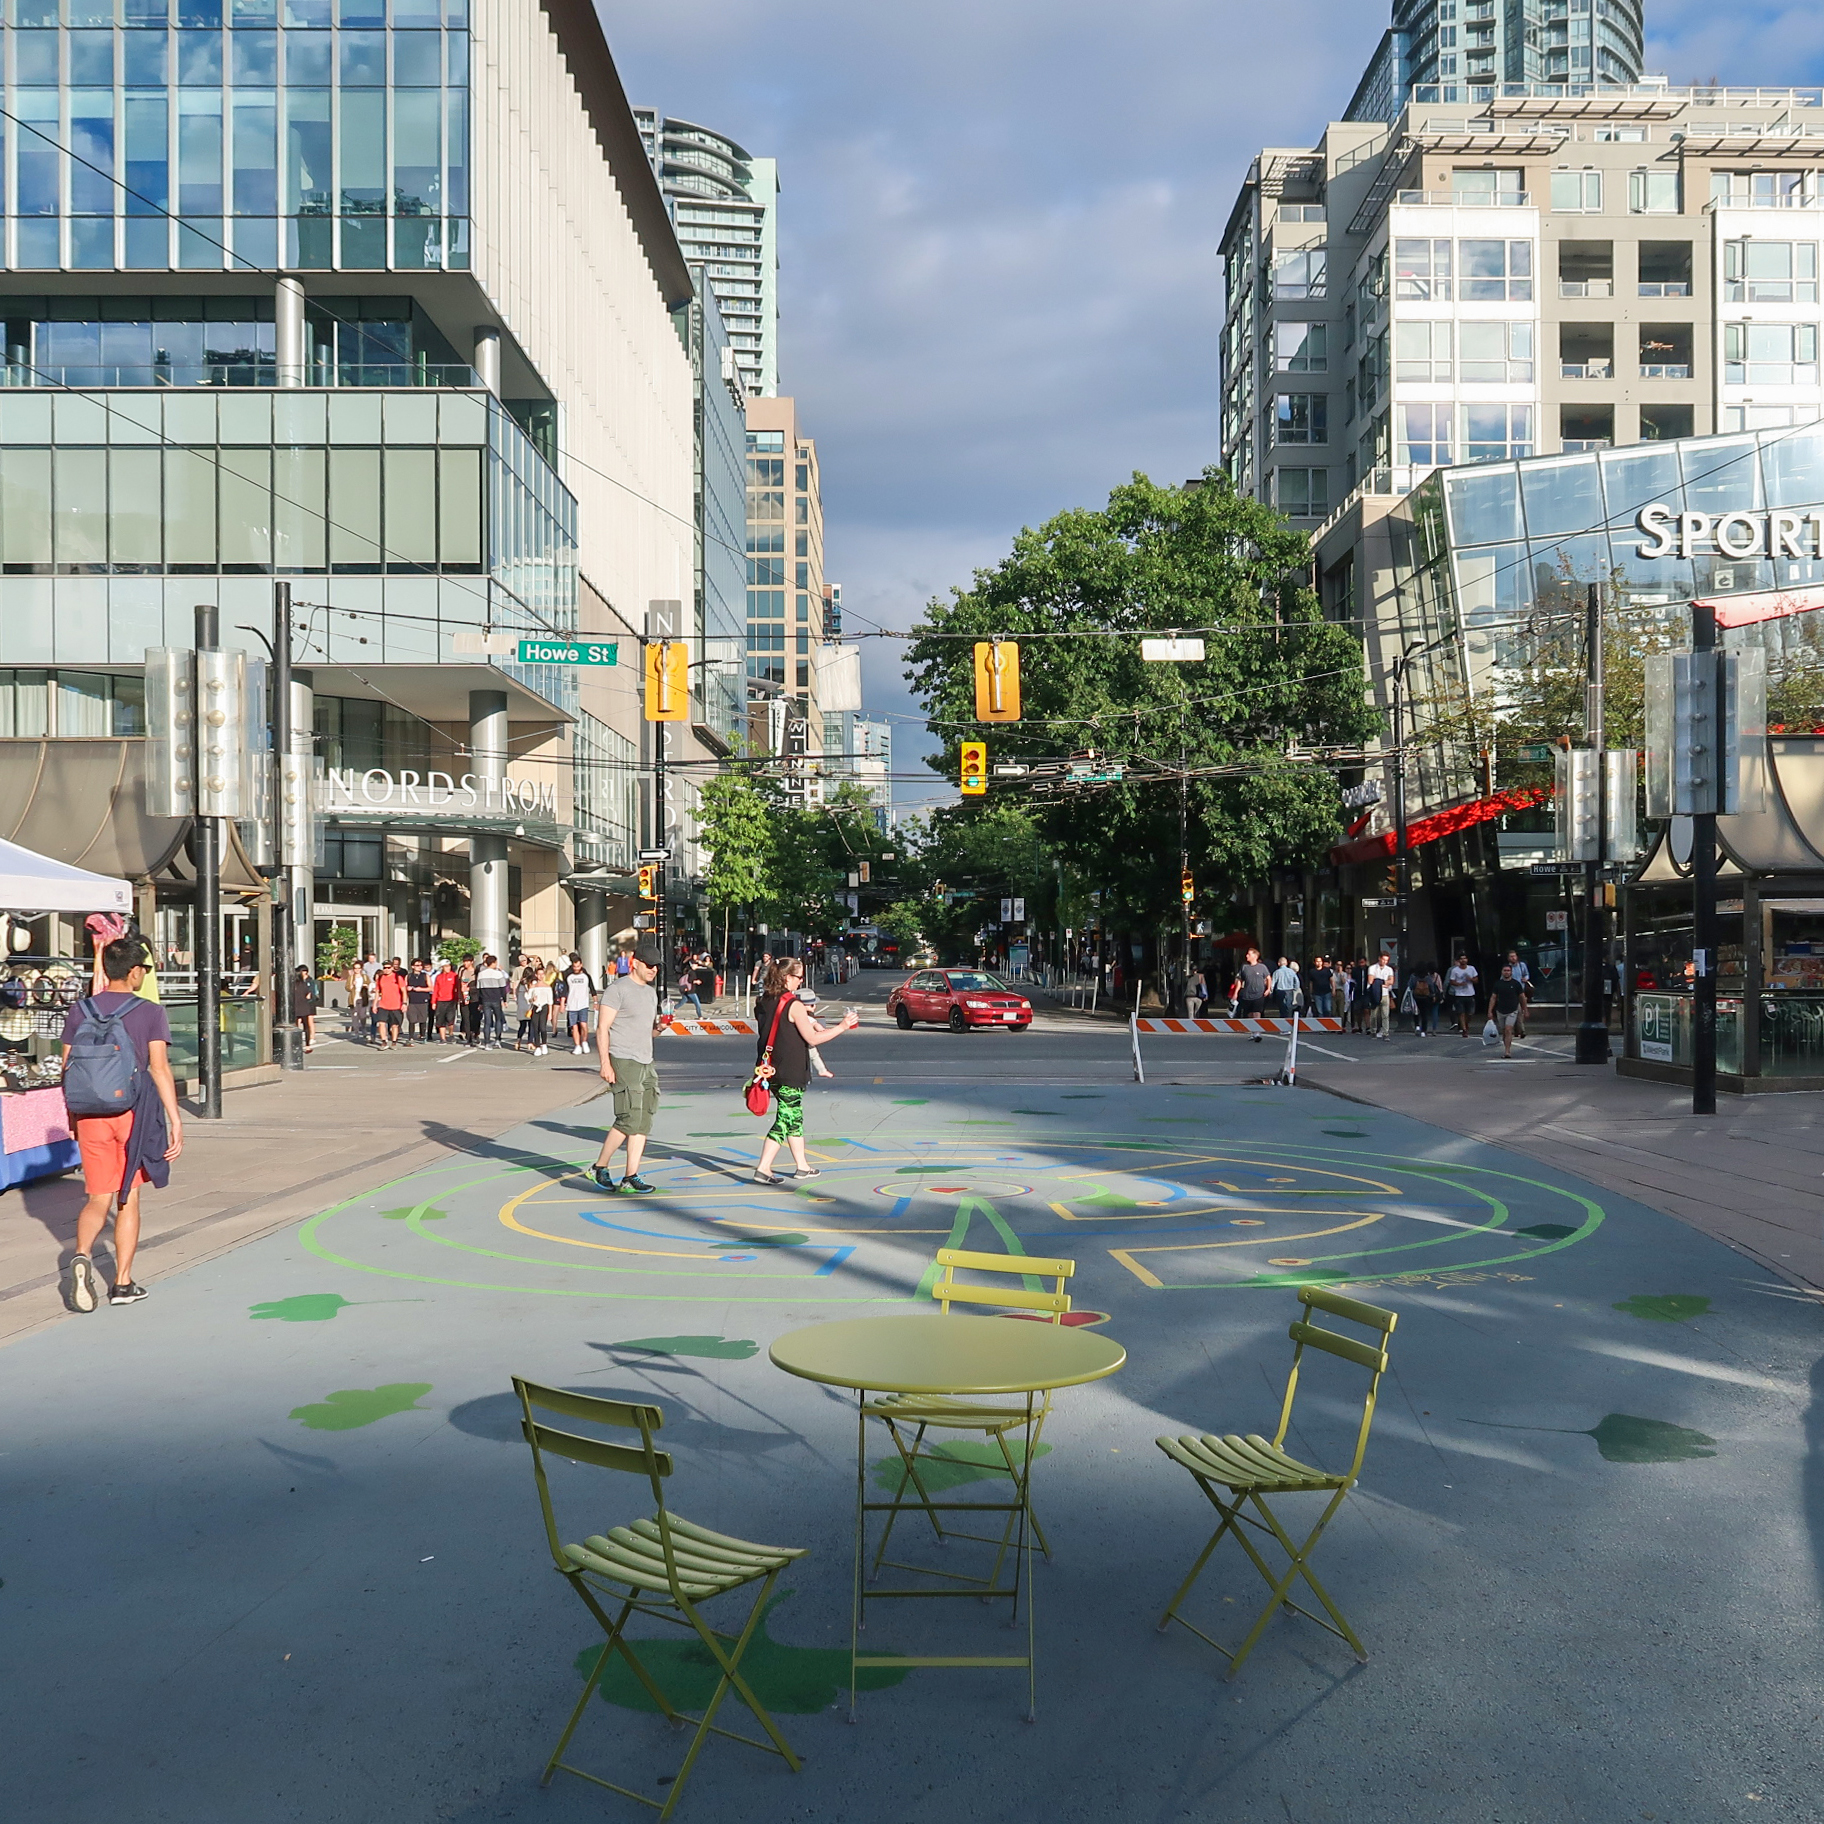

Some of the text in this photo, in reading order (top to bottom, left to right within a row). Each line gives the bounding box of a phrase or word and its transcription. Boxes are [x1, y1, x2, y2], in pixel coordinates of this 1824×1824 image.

[526, 643, 609, 662] Howe St
[328, 767, 556, 814] NORDSTROM
[1533, 865, 1556, 873] Howe
